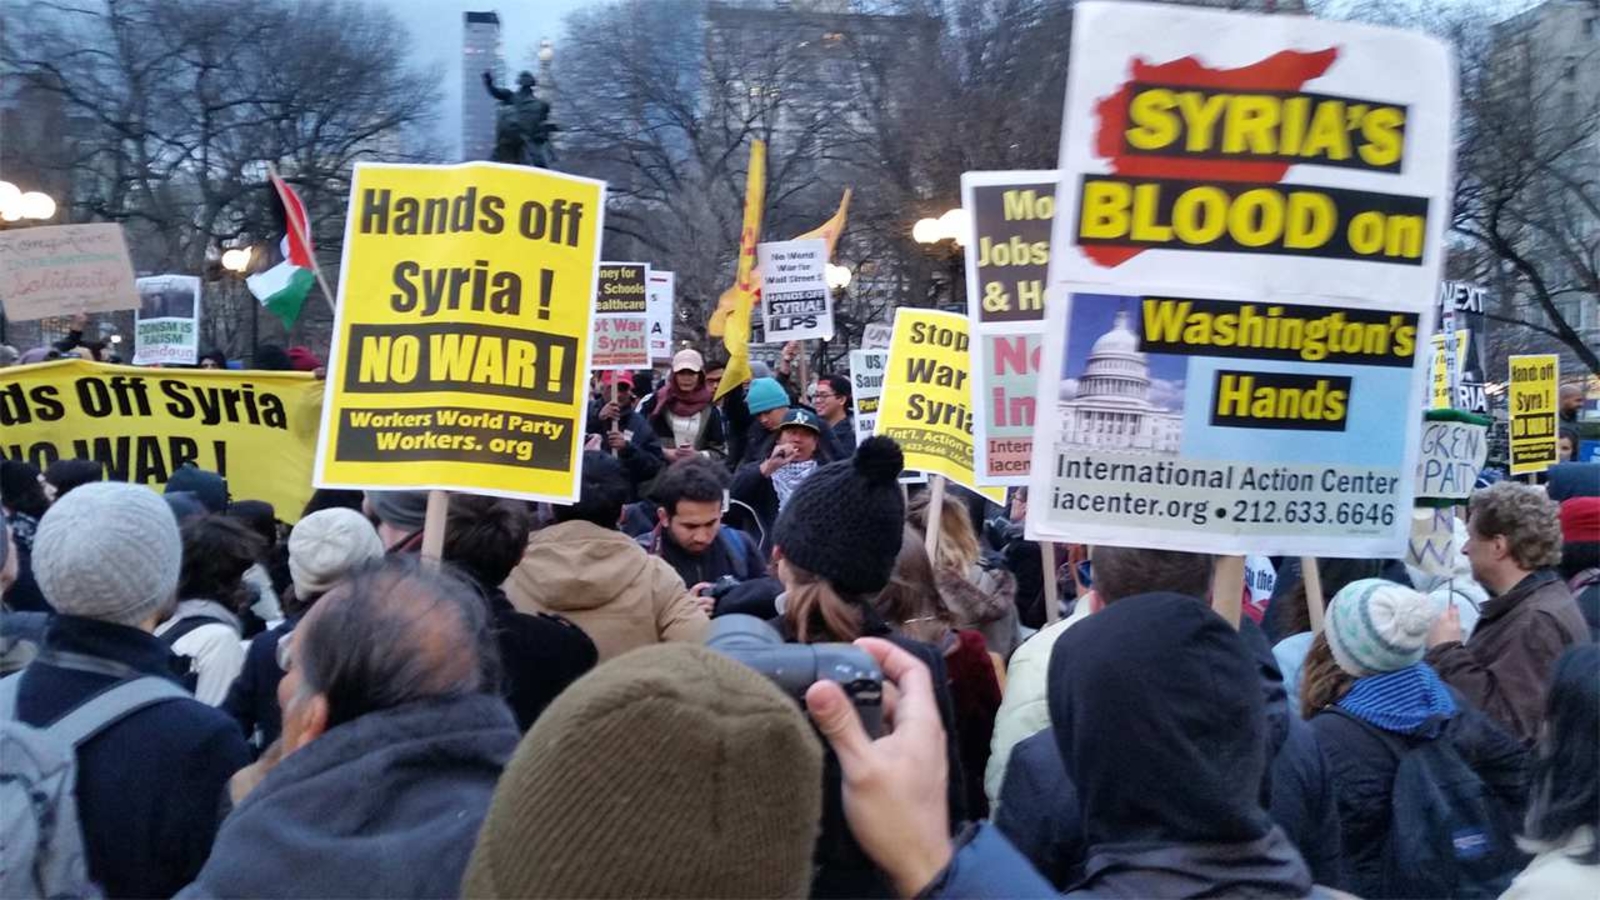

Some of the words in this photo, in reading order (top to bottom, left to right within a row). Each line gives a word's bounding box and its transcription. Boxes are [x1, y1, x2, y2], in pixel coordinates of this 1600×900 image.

[1125, 88, 1405, 167] SYRIA'S
[360, 187, 505, 236] Hands
[519, 199, 583, 247] off
[1080, 179, 1338, 249] BLOOD
[1347, 210, 1425, 260] on
[390, 260, 522, 317] Syria
[604, 283, 645, 294] Schools
[621, 267, 636, 278] for
[982, 281, 1011, 312] &
[613, 319, 645, 332] War
[1142, 300, 1416, 361] Washington's
[358, 335, 420, 383] NO
[429, 333, 536, 389] WAR
[906, 358, 967, 390] War
[75, 376, 152, 418] Off
[160, 379, 288, 430] Syria
[1215, 375, 1348, 422] Hands
[350, 411, 432, 428] Workers
[436, 410, 504, 430] World
[507, 415, 564, 440] Party
[923, 431, 963, 451] Action
[489, 437, 534, 461] org
[1056, 454, 1233, 489] International
[1239, 467, 1314, 492] Action
[1321, 469, 1400, 494] Center
[1052, 487, 1209, 525] iacenter.org
[1232, 500, 1395, 527] 212.633.6646
